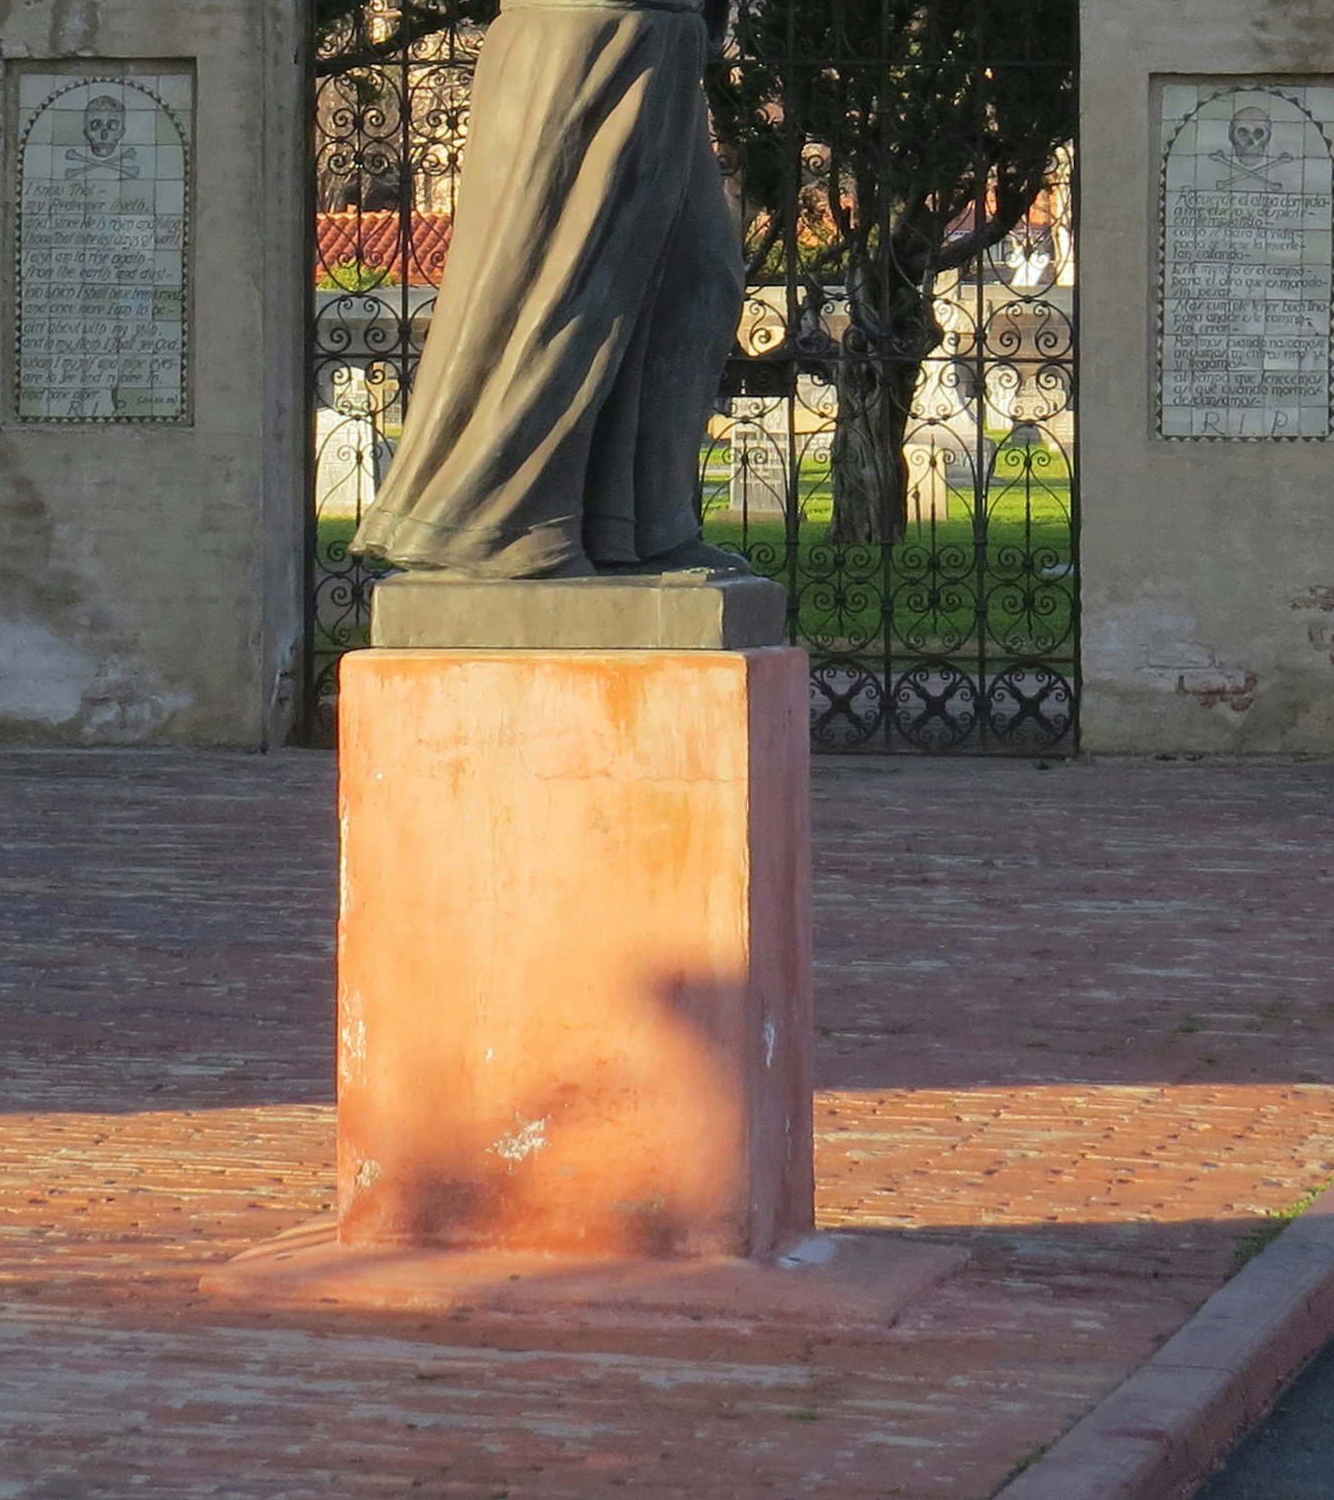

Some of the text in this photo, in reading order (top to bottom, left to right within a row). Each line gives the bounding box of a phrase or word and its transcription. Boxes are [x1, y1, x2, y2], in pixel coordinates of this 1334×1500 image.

[1175, 185, 1238, 210] Recuerde
[1250, 192, 1279, 209] alma
[25, 199, 46, 212] my
[52, 197, 106, 213] Redeemer
[97, 215, 106, 230] is
[1174, 240, 1206, 249] como
[30, 250, 52, 265] also
[54, 251, 73, 264] am
[74, 250, 86, 263] to
[88, 248, 110, 264] rise
[24, 265, 54, 279] from
[56, 266, 75, 279] the
[79, 266, 112, 281] earth
[116, 267, 137, 280] and
[1172, 278, 1200, 289] para
[1173, 288, 1191, 298] sin
[114, 304, 132, 316] am
[135, 303, 150, 316] to
[1174, 359, 1185, 370] y
[23, 373, 43, 384] are
[1174, 371, 1187, 383] al
[1234, 374, 1257, 386] que
